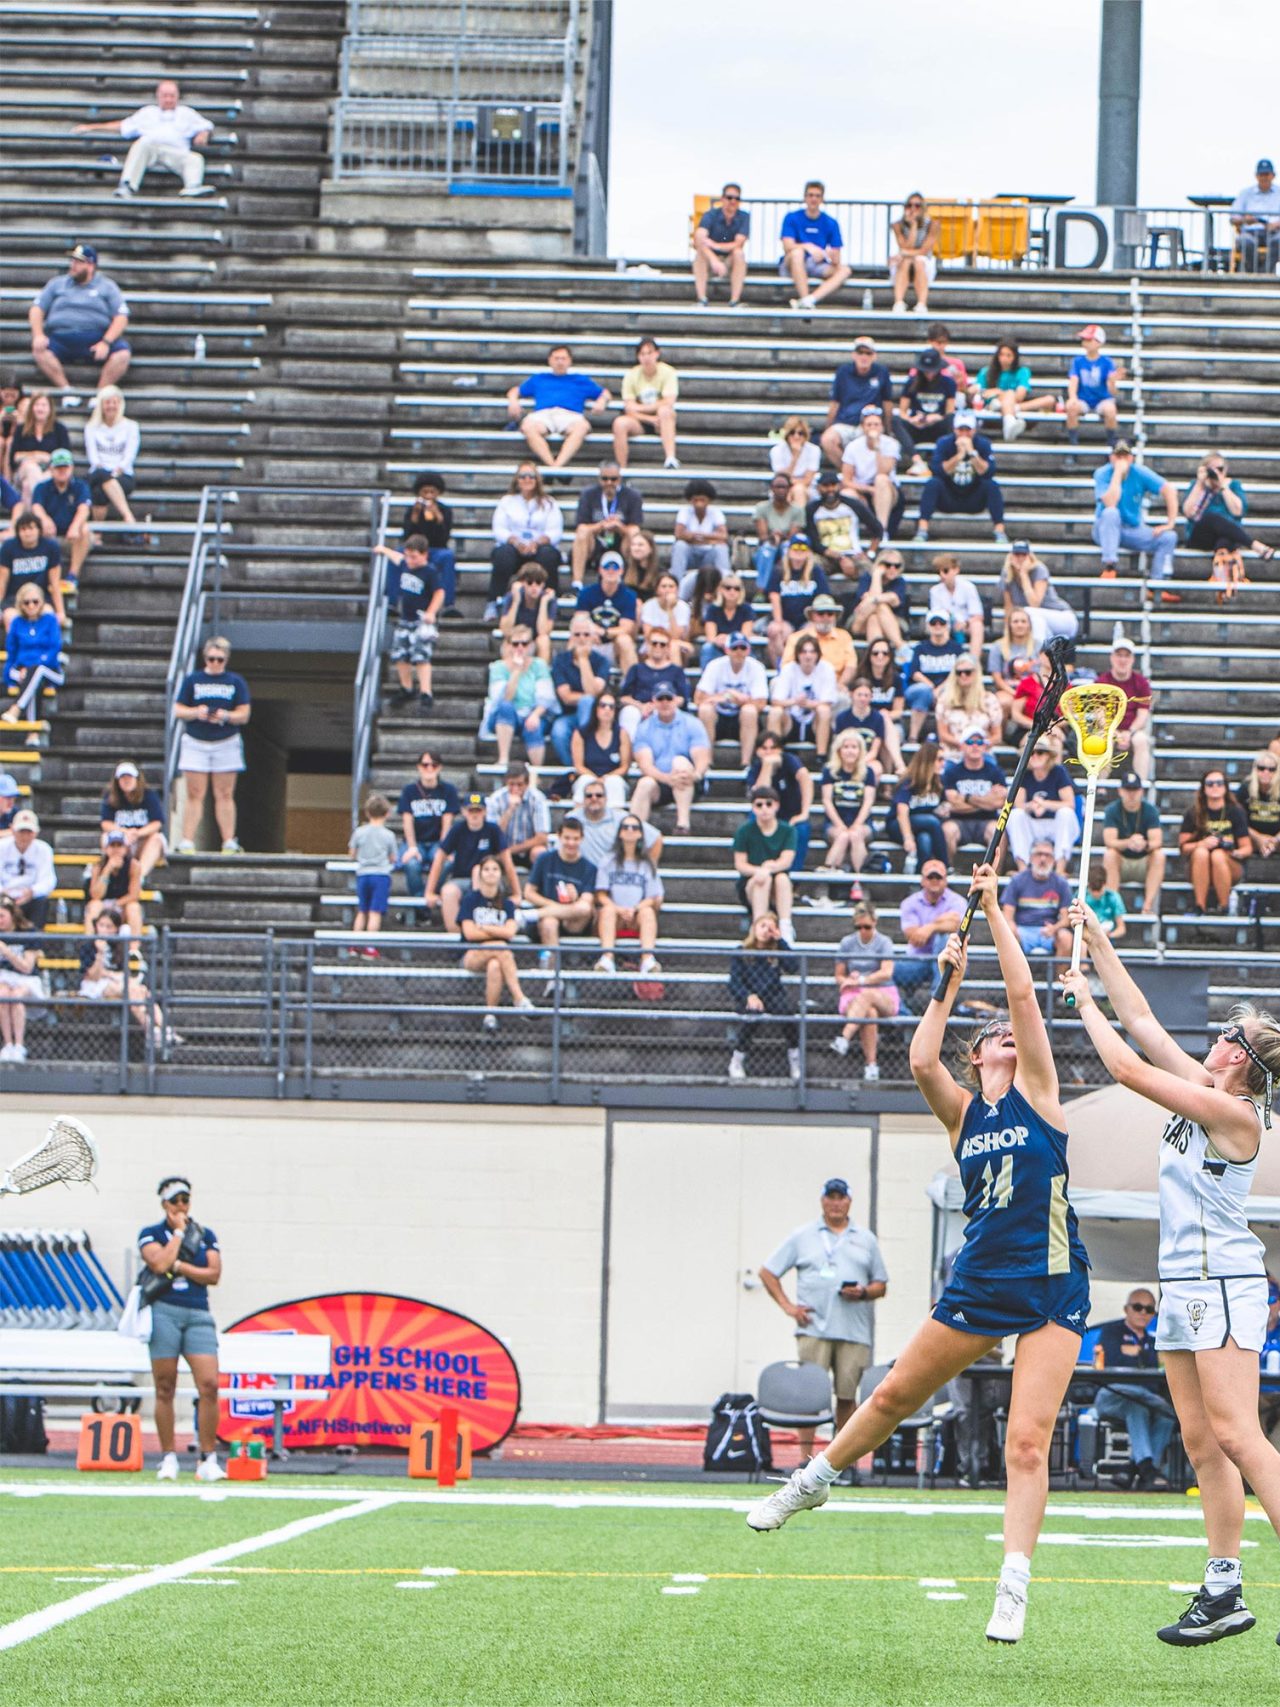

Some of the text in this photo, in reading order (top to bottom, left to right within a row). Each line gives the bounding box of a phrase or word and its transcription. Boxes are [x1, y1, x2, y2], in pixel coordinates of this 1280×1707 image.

[1055, 211, 1109, 269] D
[961, 1125, 1029, 1160] BISHOP
[979, 1154, 1014, 1209] 14
[379, 1346, 486, 1377] SCHOOL
[304, 1371, 487, 1400] HAPPENS HERE
[87, 1421, 133, 1462] 10
